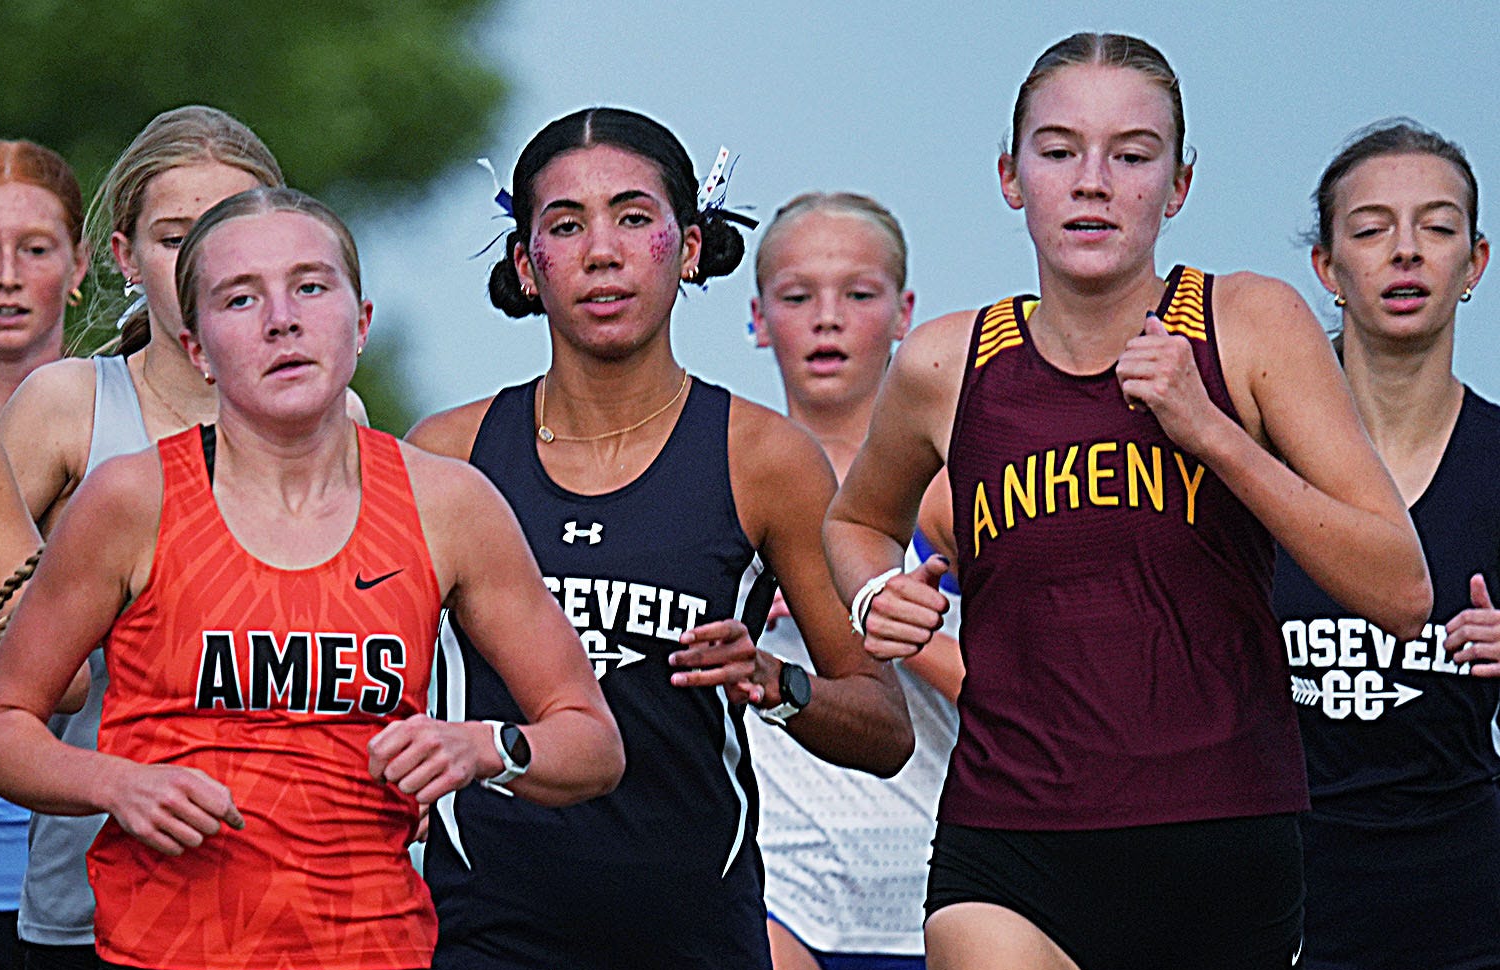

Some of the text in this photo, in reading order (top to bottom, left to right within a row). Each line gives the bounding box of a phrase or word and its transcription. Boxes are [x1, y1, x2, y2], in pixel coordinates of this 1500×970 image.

[973, 441, 1205, 558] ANKENY
[195, 630, 406, 716] AMES
[1321, 669, 1385, 721] CC
